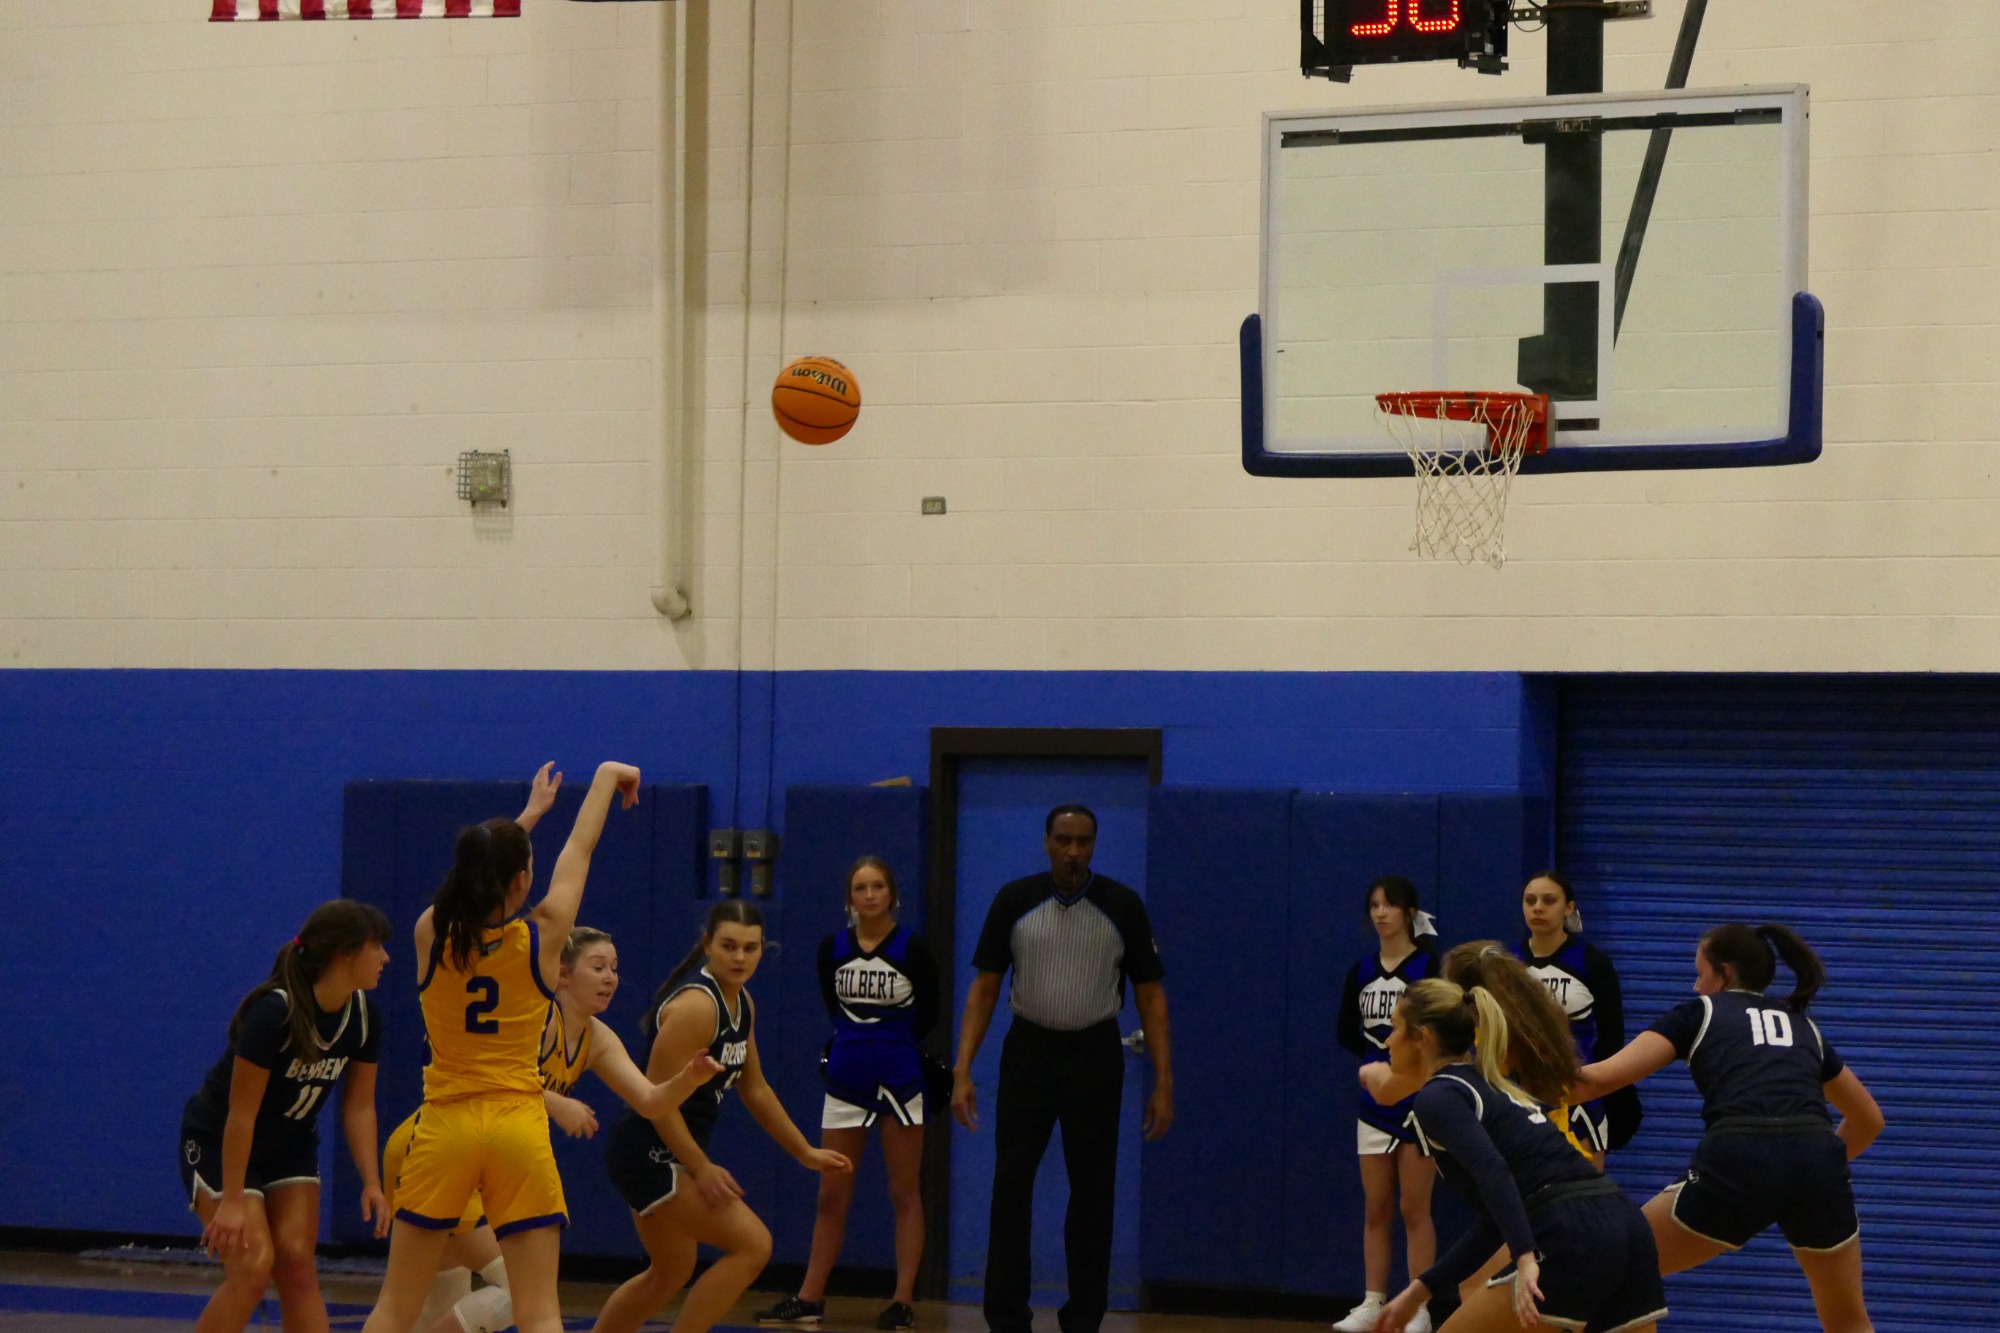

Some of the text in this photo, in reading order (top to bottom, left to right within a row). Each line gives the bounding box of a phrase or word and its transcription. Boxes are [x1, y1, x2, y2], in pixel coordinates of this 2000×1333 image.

[791, 367, 848, 397] Wilson
[465, 975, 500, 1035] 2
[1360, 990, 1399, 1020] HILBE
[1745, 1007, 1794, 1048] 10
[284, 1055, 350, 1083] BEHREN
[282, 1084, 323, 1121] 11
